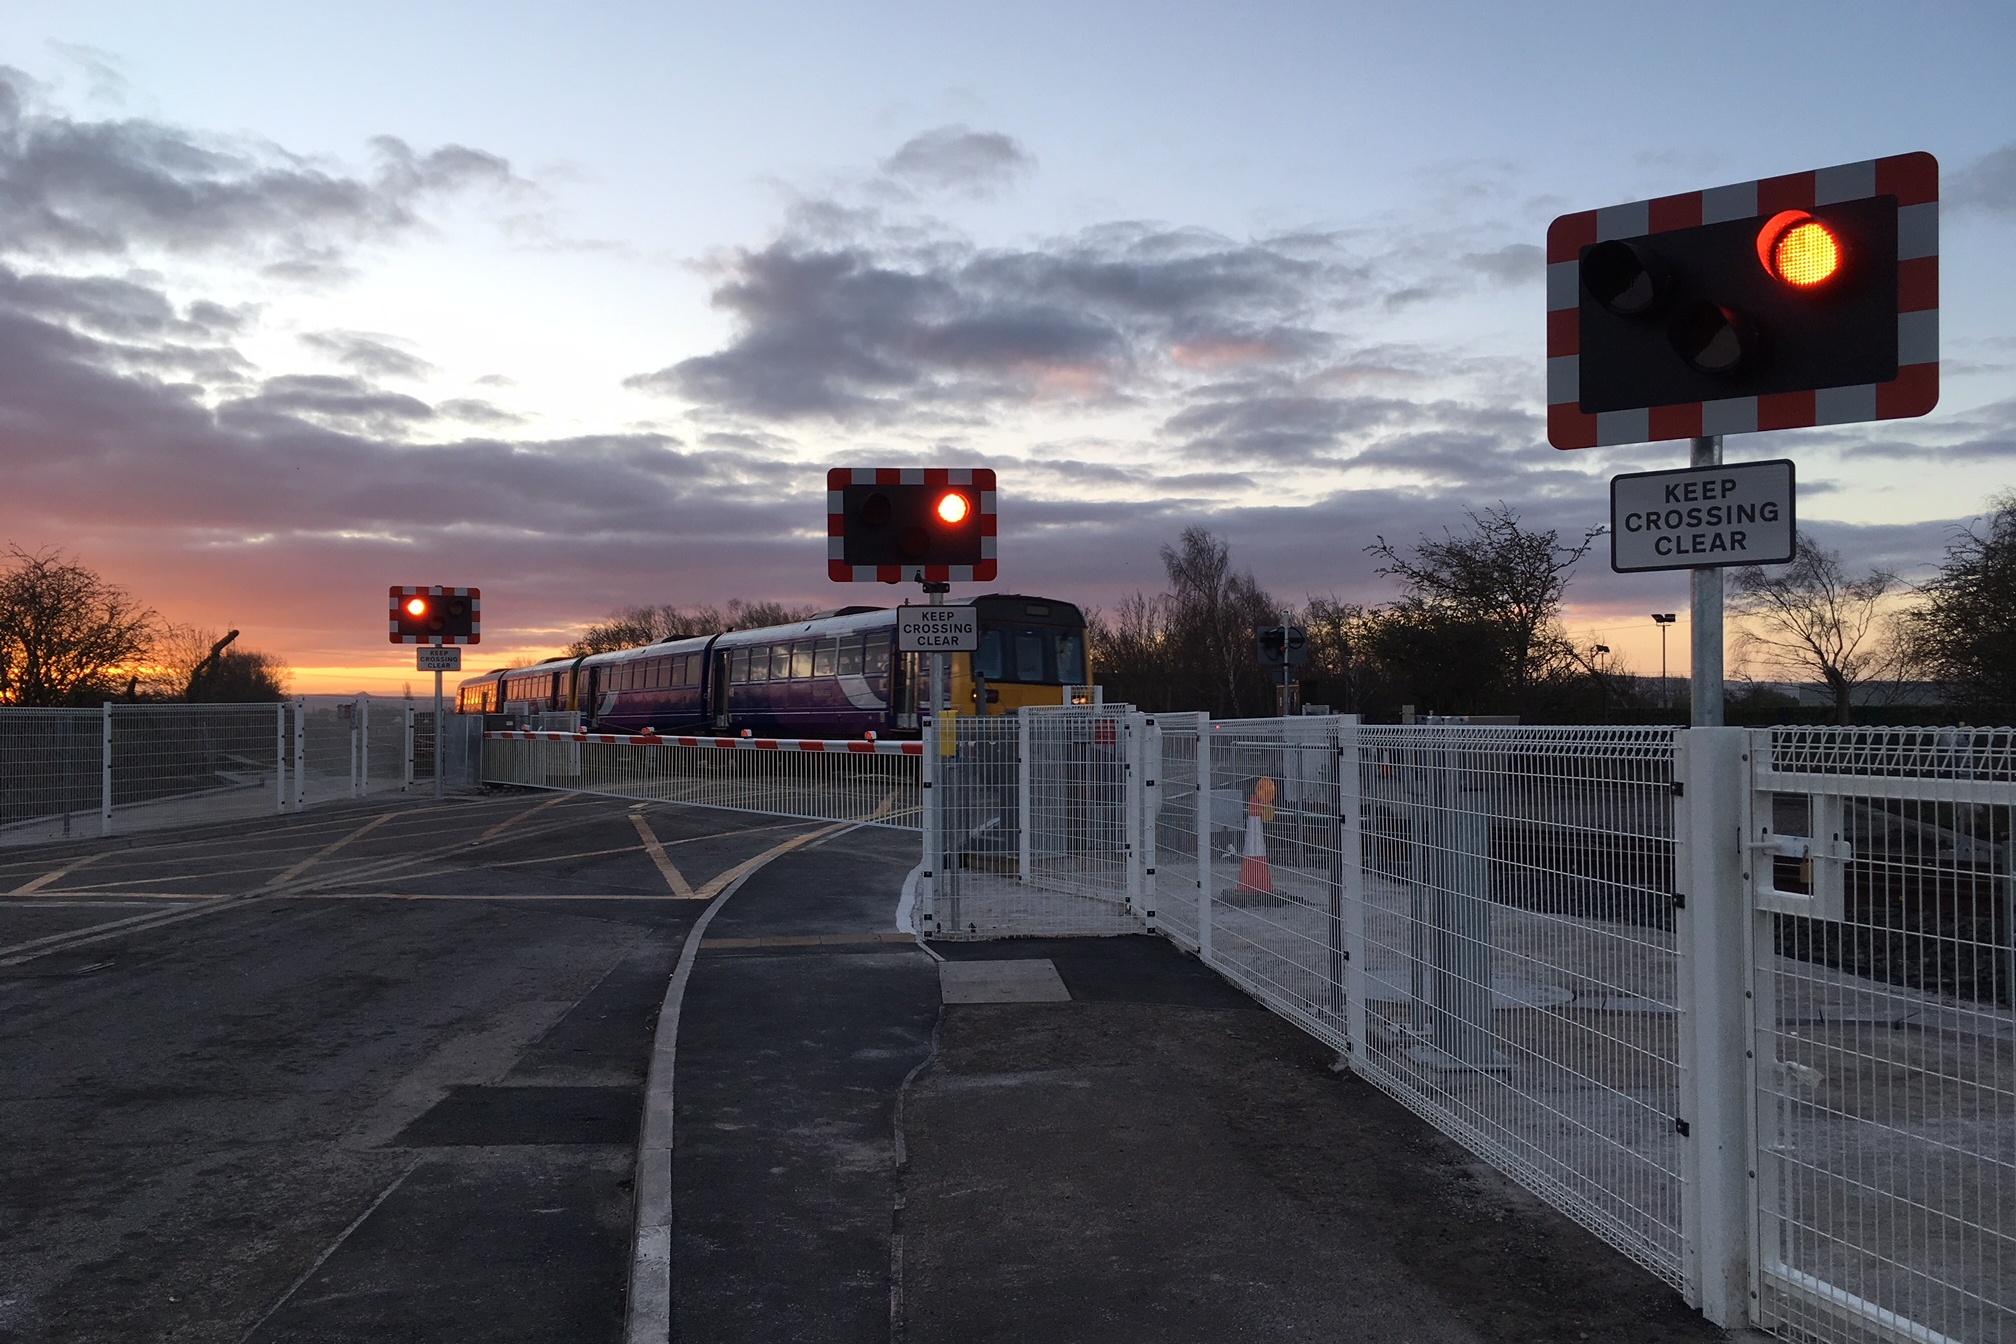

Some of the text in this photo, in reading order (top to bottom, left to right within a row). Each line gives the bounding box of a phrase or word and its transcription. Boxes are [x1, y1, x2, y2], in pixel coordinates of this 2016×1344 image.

[1665, 479, 1737, 503] KEEP
[1625, 501, 1779, 532] CROSSING
[1654, 530, 1747, 556] CLEAR
[922, 611, 955, 622] KEEP
[903, 623, 973, 634] CROSSING
[917, 635, 959, 646] CLEAR
